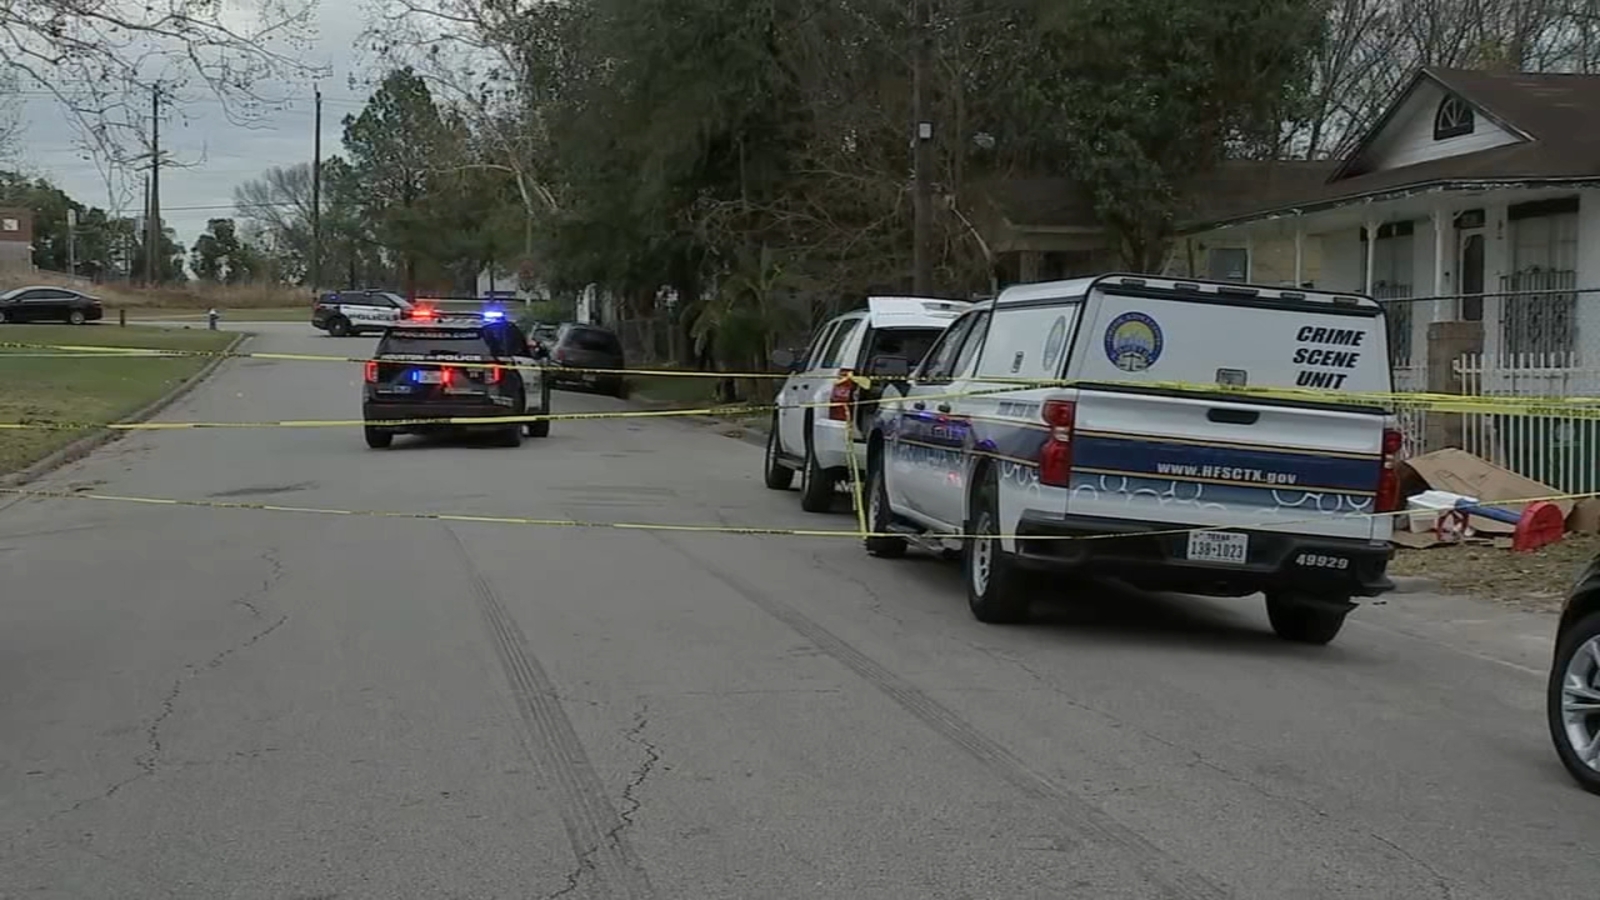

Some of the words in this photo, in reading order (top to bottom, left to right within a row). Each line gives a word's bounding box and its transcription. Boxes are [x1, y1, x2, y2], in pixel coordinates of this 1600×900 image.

[1296, 326, 1366, 347] CRIME
[1293, 348, 1361, 369] SCENE
[1296, 370, 1347, 389] UNIT
[1157, 463, 1297, 484] www.HFSCTX.gov
[1296, 554, 1349, 569] 49929
